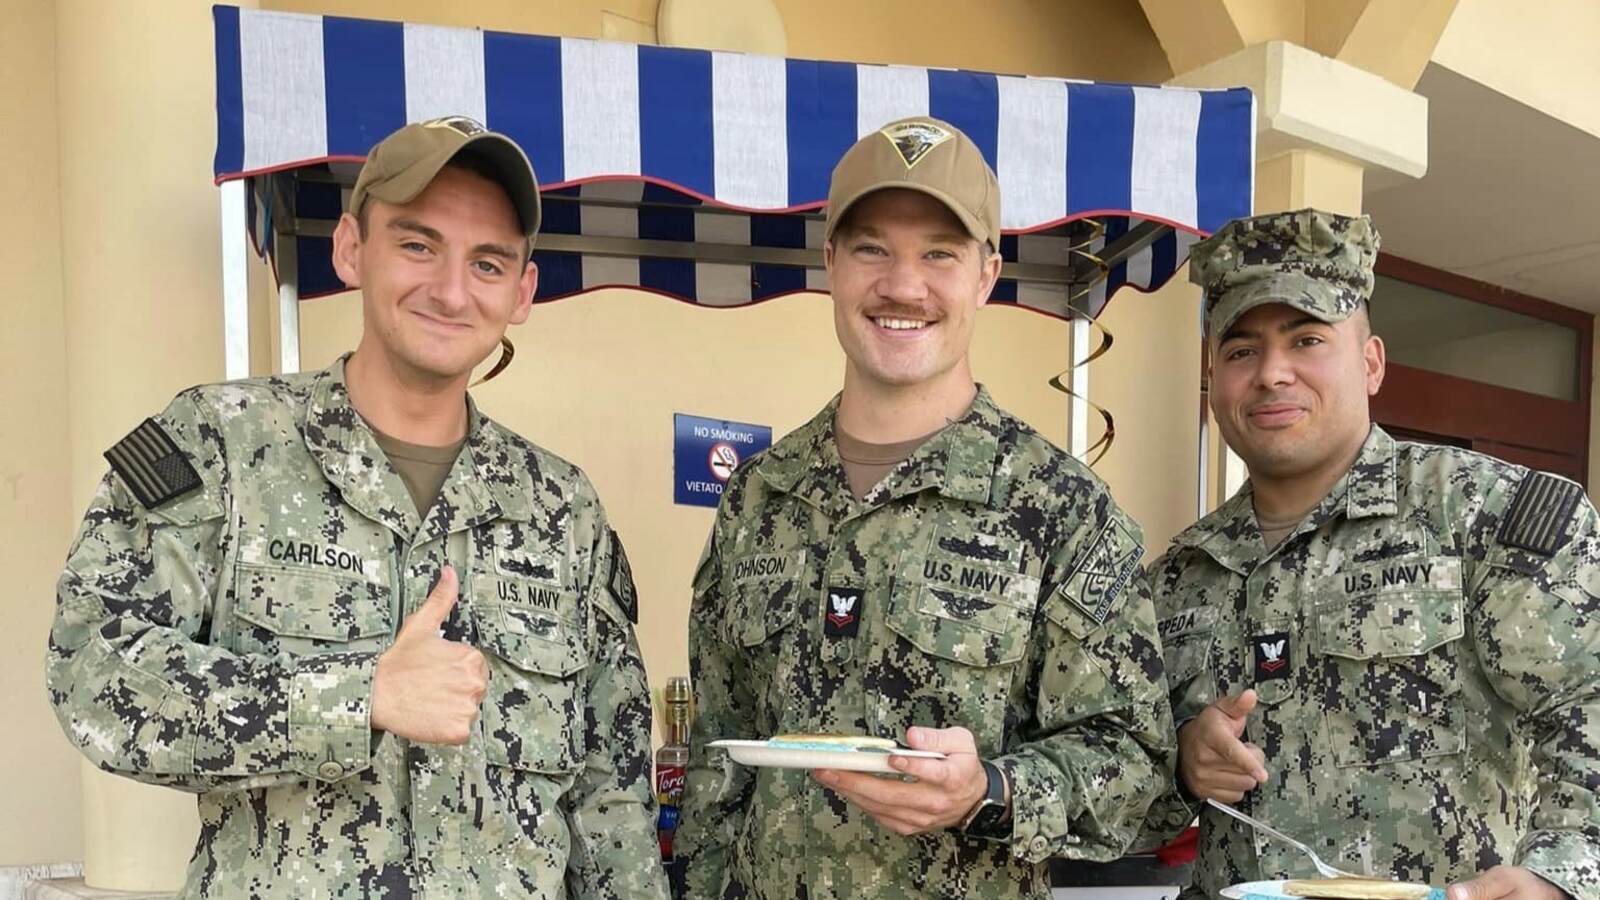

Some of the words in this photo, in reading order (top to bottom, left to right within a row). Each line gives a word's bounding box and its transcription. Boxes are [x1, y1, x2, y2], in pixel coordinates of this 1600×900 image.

[694, 426, 709, 438] NO
[710, 428, 753, 443] SMOKING
[685, 481, 723, 494] VIETATO
[269, 539, 364, 575] CARLSON
[923, 559, 955, 584] U.S.
[960, 567, 1010, 595] NAVY
[1344, 573, 1377, 594] U.S.
[1381, 563, 1434, 586] NAVY
[497, 581, 522, 603] U.S.
[528, 586, 560, 611] NAVY
